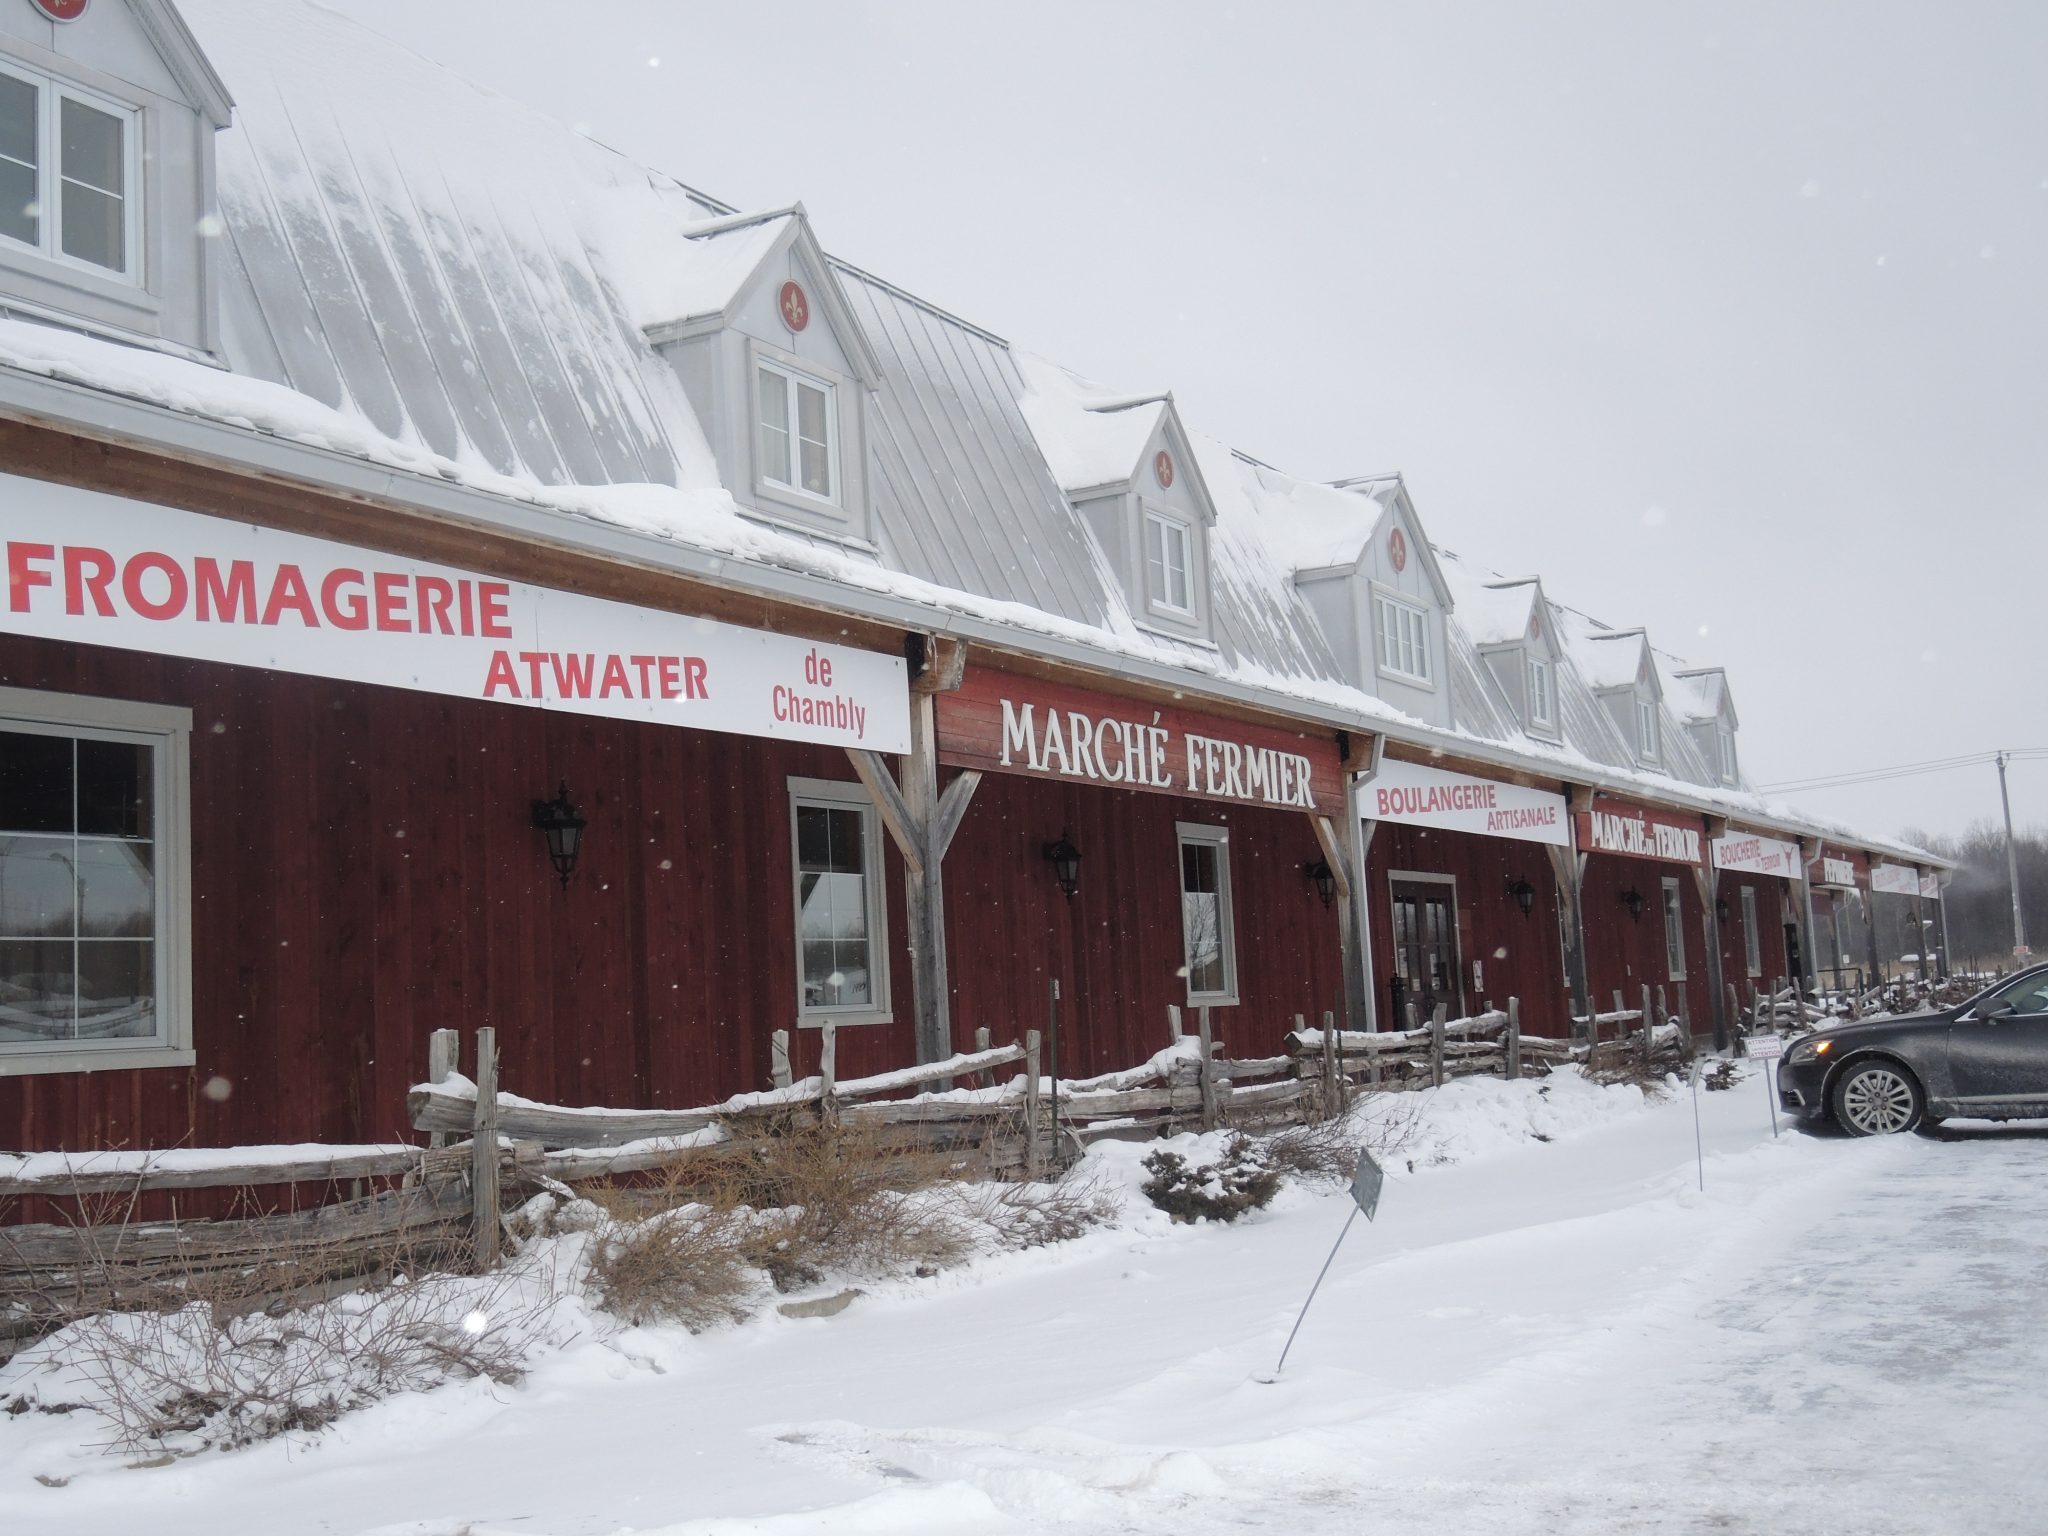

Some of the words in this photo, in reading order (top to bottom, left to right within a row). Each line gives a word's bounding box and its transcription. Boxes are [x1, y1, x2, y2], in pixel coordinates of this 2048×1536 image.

[7, 541, 513, 639] FROMAGERIE
[482, 650, 709, 700] ATWATER
[804, 648, 832, 687] de
[772, 685, 866, 739] Chambly
[1000, 699, 1172, 788] MARCHÉ
[1184, 733, 1316, 809] FERMIER
[1377, 785, 1497, 816] BOULANGERIE
[1487, 806, 1556, 831] ARTISANALE
[1590, 810, 1647, 855] MARCHÉ
[1652, 823, 1702, 862] TERROIR
[1720, 839, 1761, 865] BOUCHERIE
